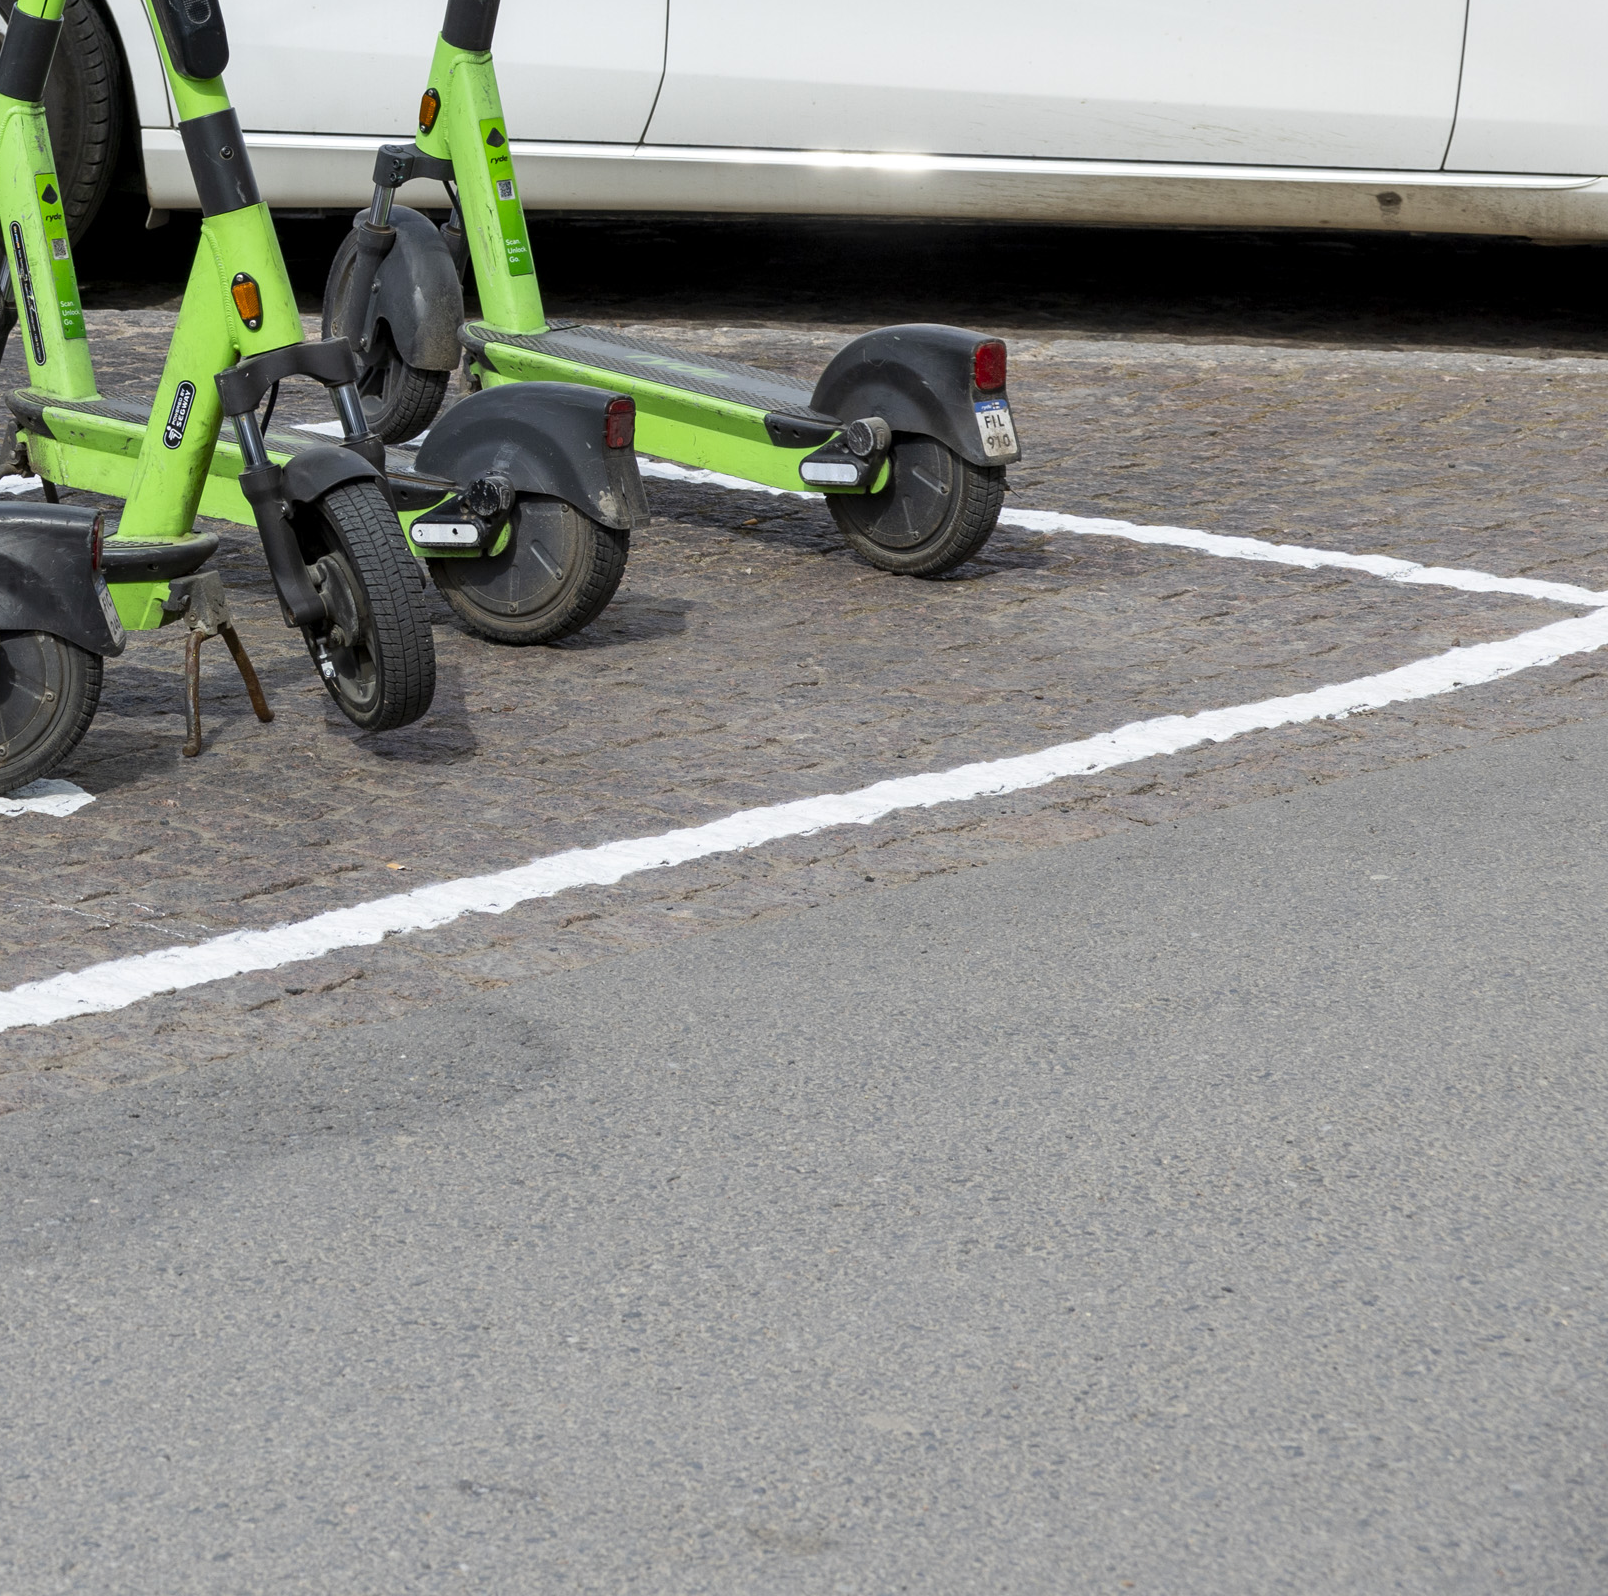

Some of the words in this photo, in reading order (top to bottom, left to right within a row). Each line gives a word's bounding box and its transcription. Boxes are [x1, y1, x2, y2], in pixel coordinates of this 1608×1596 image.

[490, 155, 508, 164] ryde
[45, 212, 63, 222] ryde
[171, 397, 183, 426] POWERED
[176, 389, 191, 428] SEGWAY
[984, 414, 1005, 429] FIL
[987, 434, 1011, 449] 910
